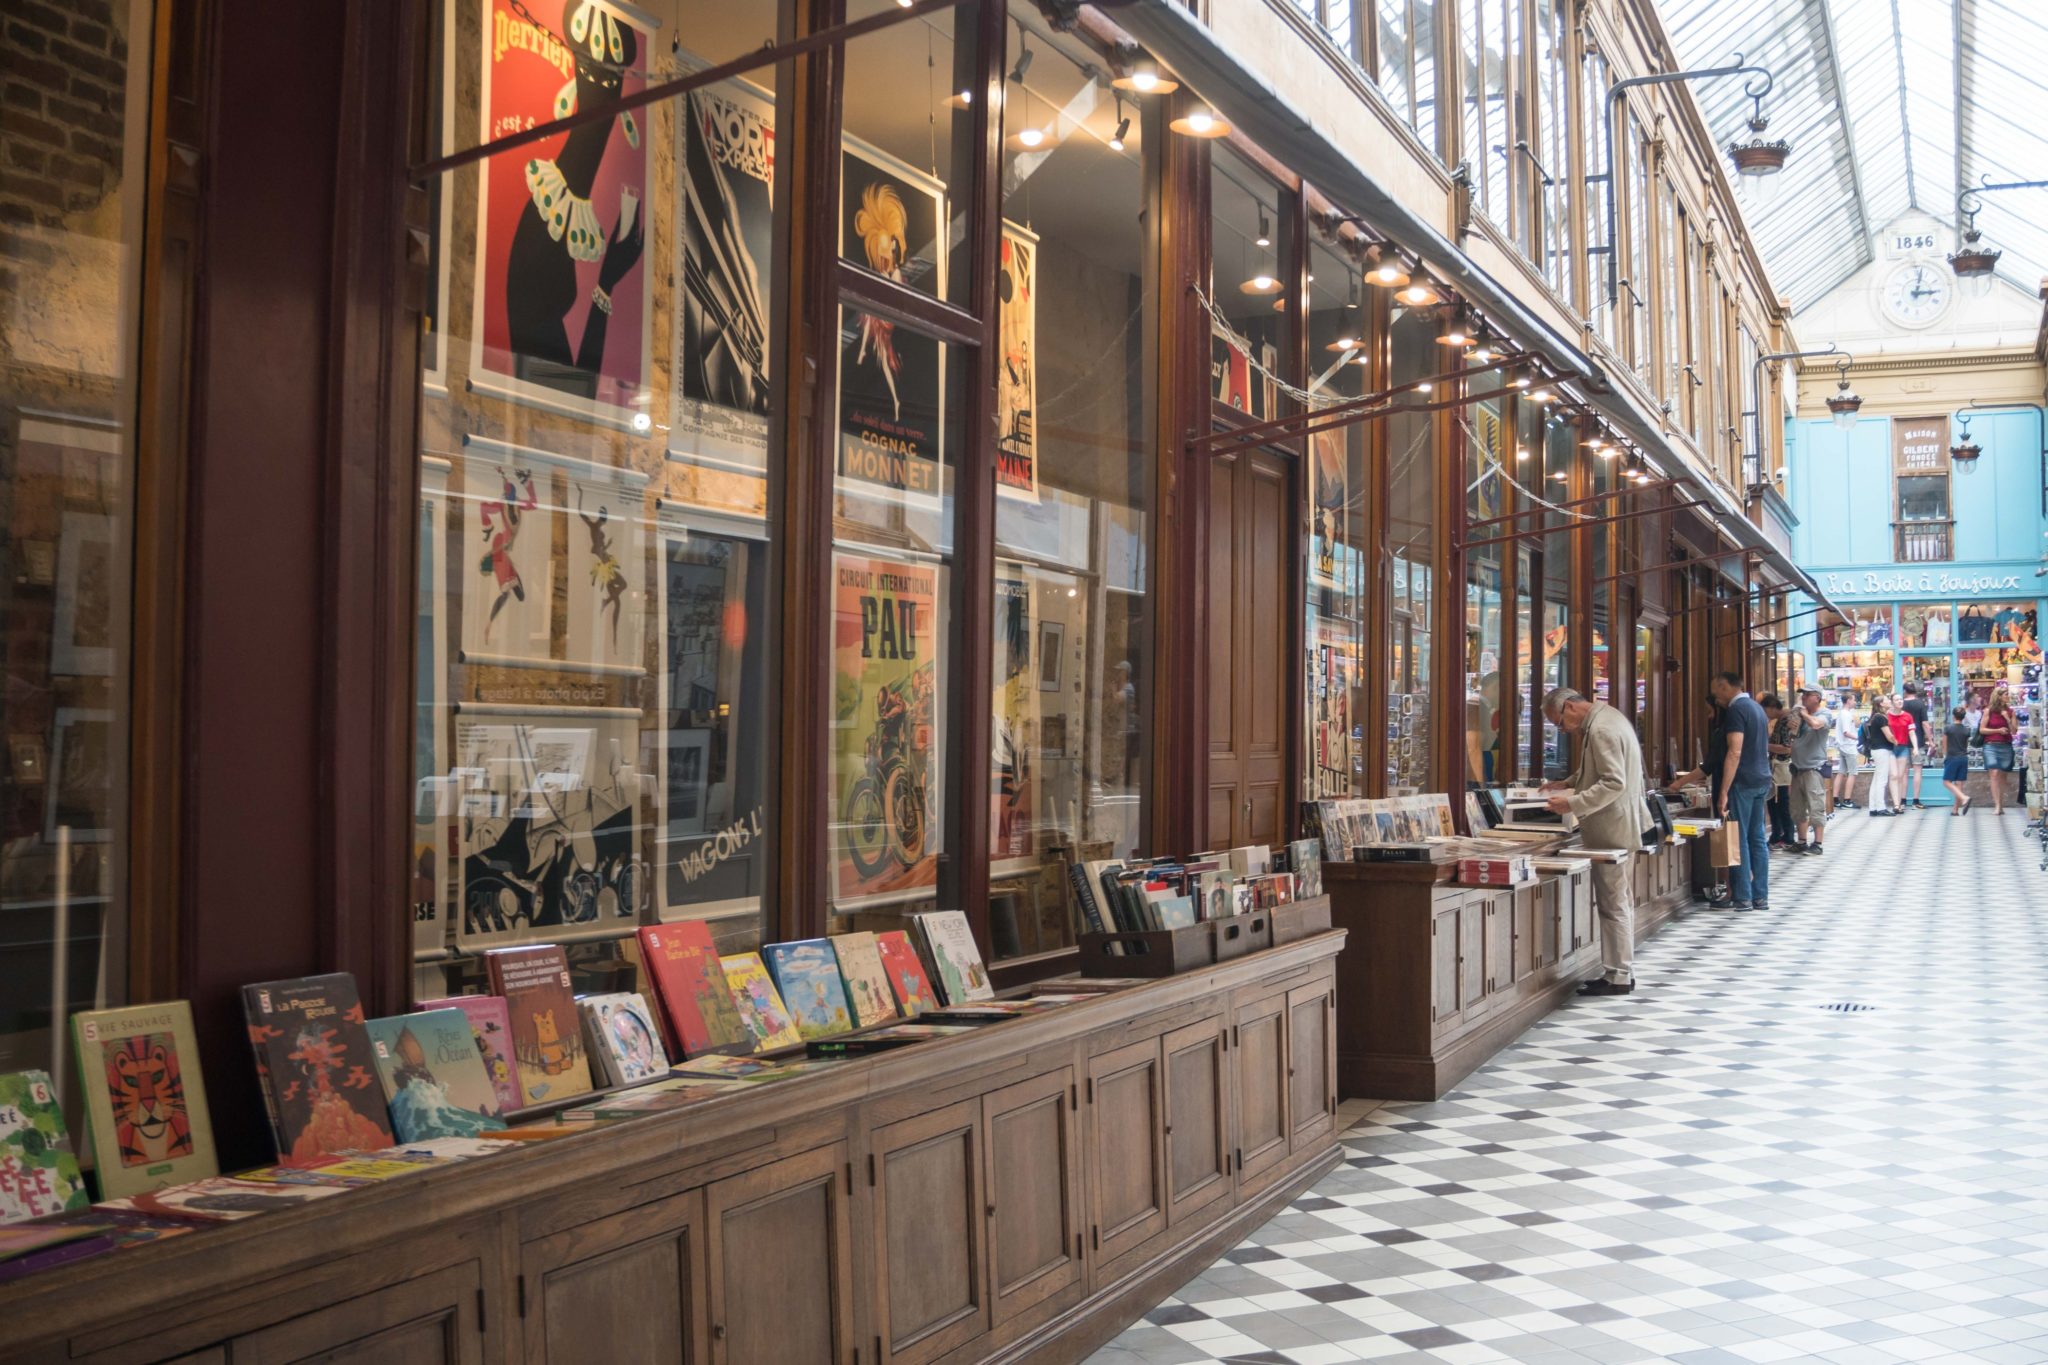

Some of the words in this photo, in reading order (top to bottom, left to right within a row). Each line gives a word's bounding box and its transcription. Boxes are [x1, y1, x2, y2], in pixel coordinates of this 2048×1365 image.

[1896, 235, 1933, 249] 1846
[861, 430, 917, 457] COGNAC
[1903, 444, 1939, 454] GILBERT
[847, 446, 933, 490] MONNET
[839, 567, 873, 590] CIRCUIT
[876, 573, 933, 596] INTERNATIONAL
[1827, 574, 1857, 594] La
[1919, 575, 1935, 592] à
[860, 596, 917, 660] PAU
[1318, 766, 1347, 798] FOLIE
[678, 816, 750, 885] WAGONS
[121, 1014, 173, 1030] SAUVAGE
